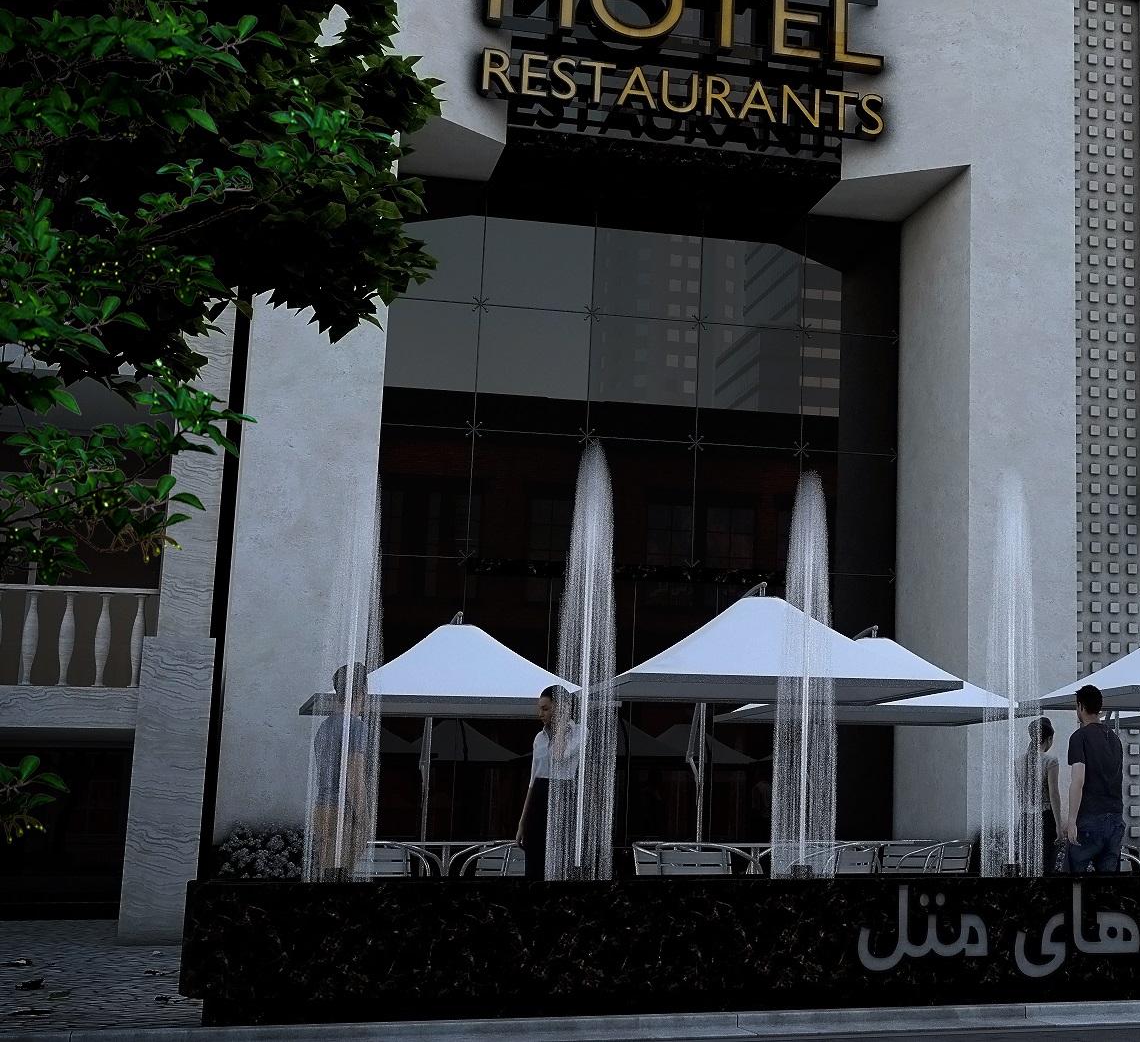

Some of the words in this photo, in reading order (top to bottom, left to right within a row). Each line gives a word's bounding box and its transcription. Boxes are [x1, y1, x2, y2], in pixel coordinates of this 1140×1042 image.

[481, 47, 885, 138] RESTAURANTS
[857, 884, 989, 972] متل
[1014, 883, 1140, 979] های
